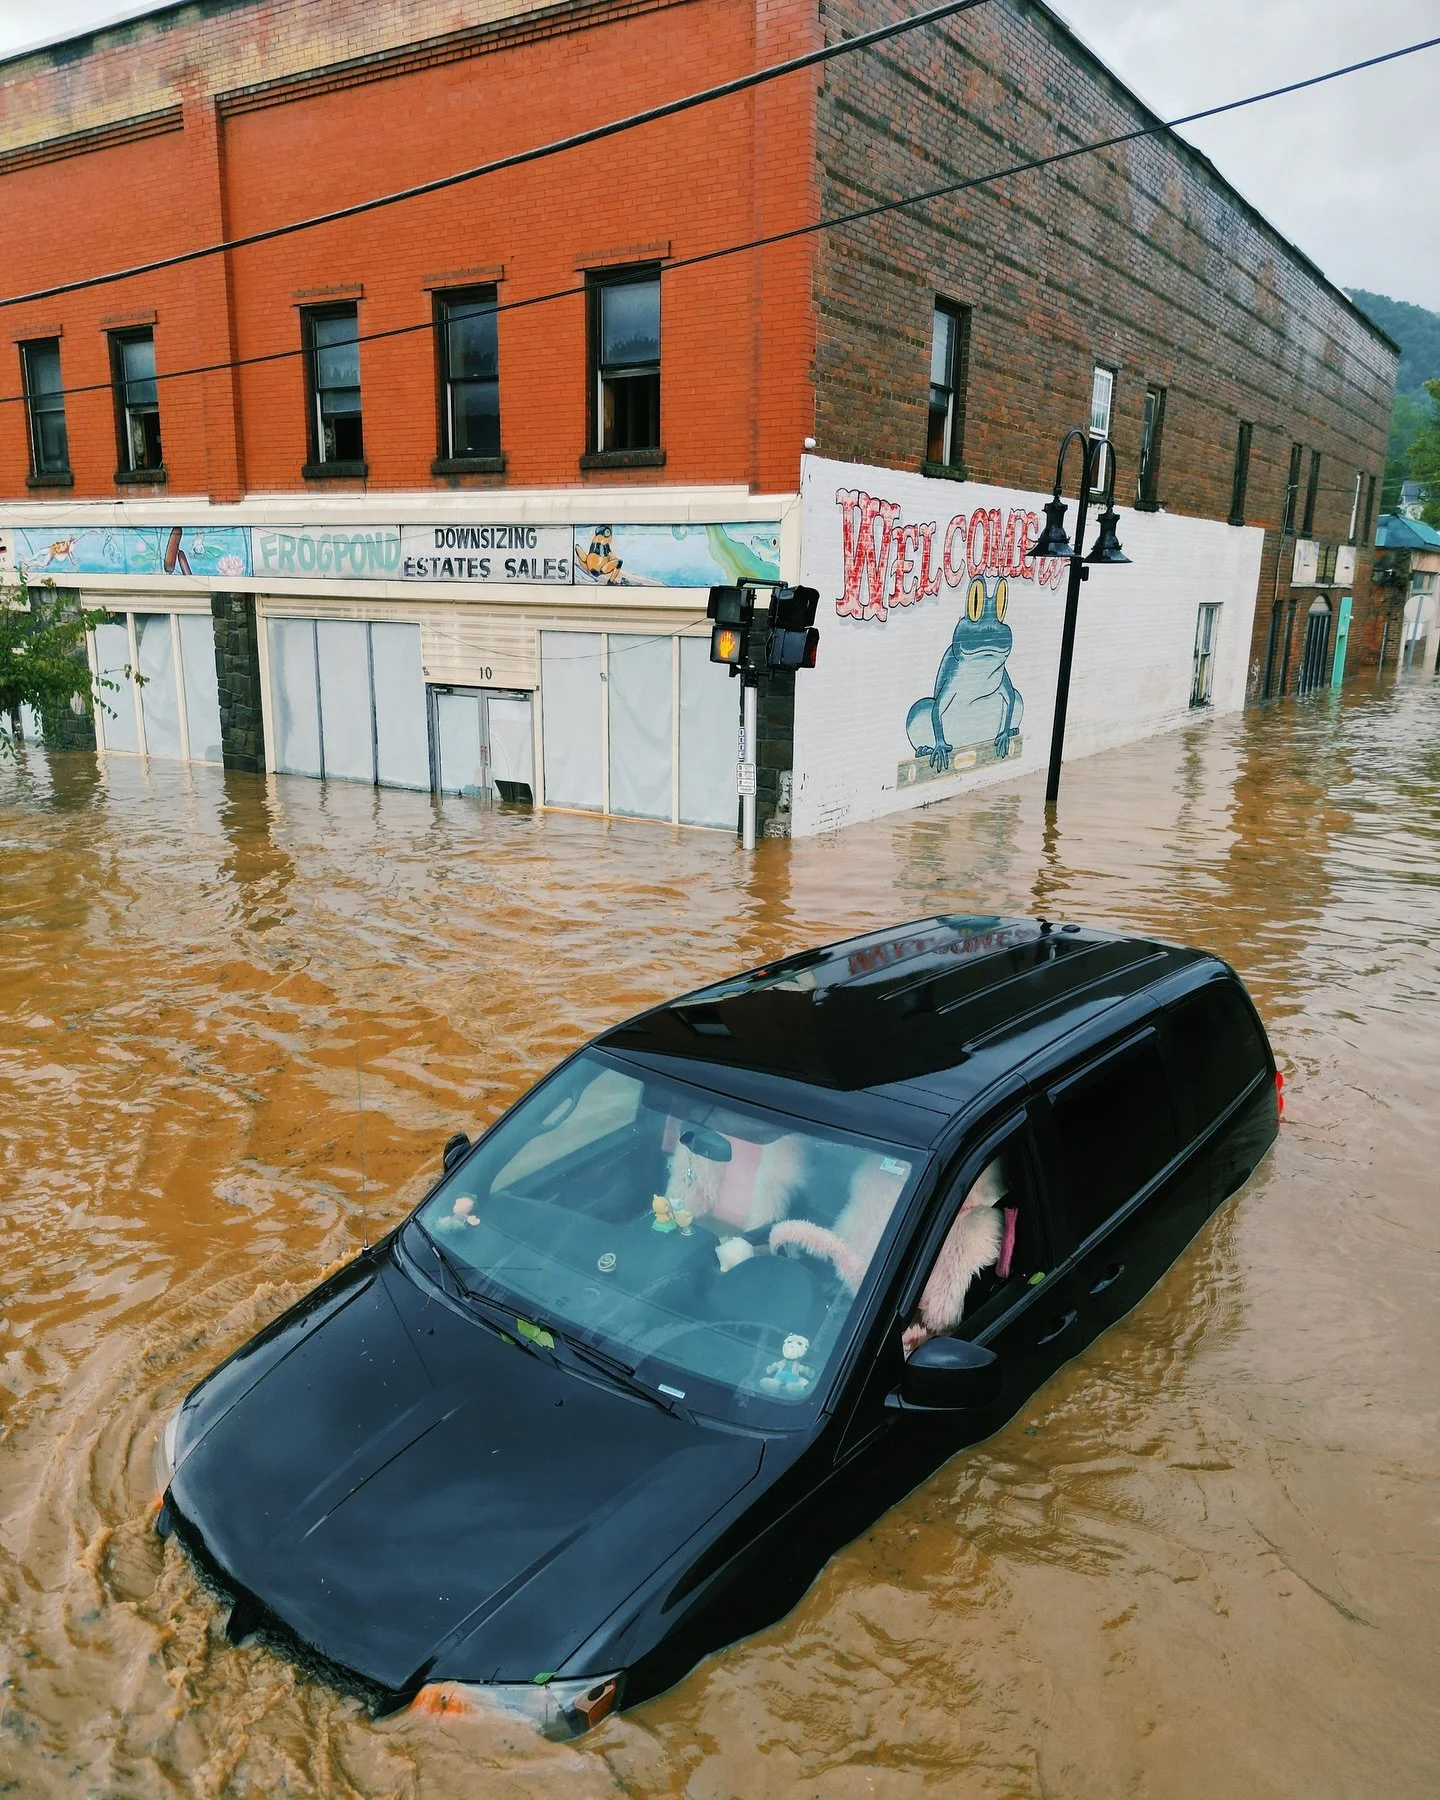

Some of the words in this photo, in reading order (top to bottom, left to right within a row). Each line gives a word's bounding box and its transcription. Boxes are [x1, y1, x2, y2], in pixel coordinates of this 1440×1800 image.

[434, 527, 538, 549] DOWNSIZING
[260, 532, 400, 573] FROGPOND
[403, 556, 491, 578] ESTATES
[504, 558, 569, 580] SALES
[479, 666, 493, 680] 10
